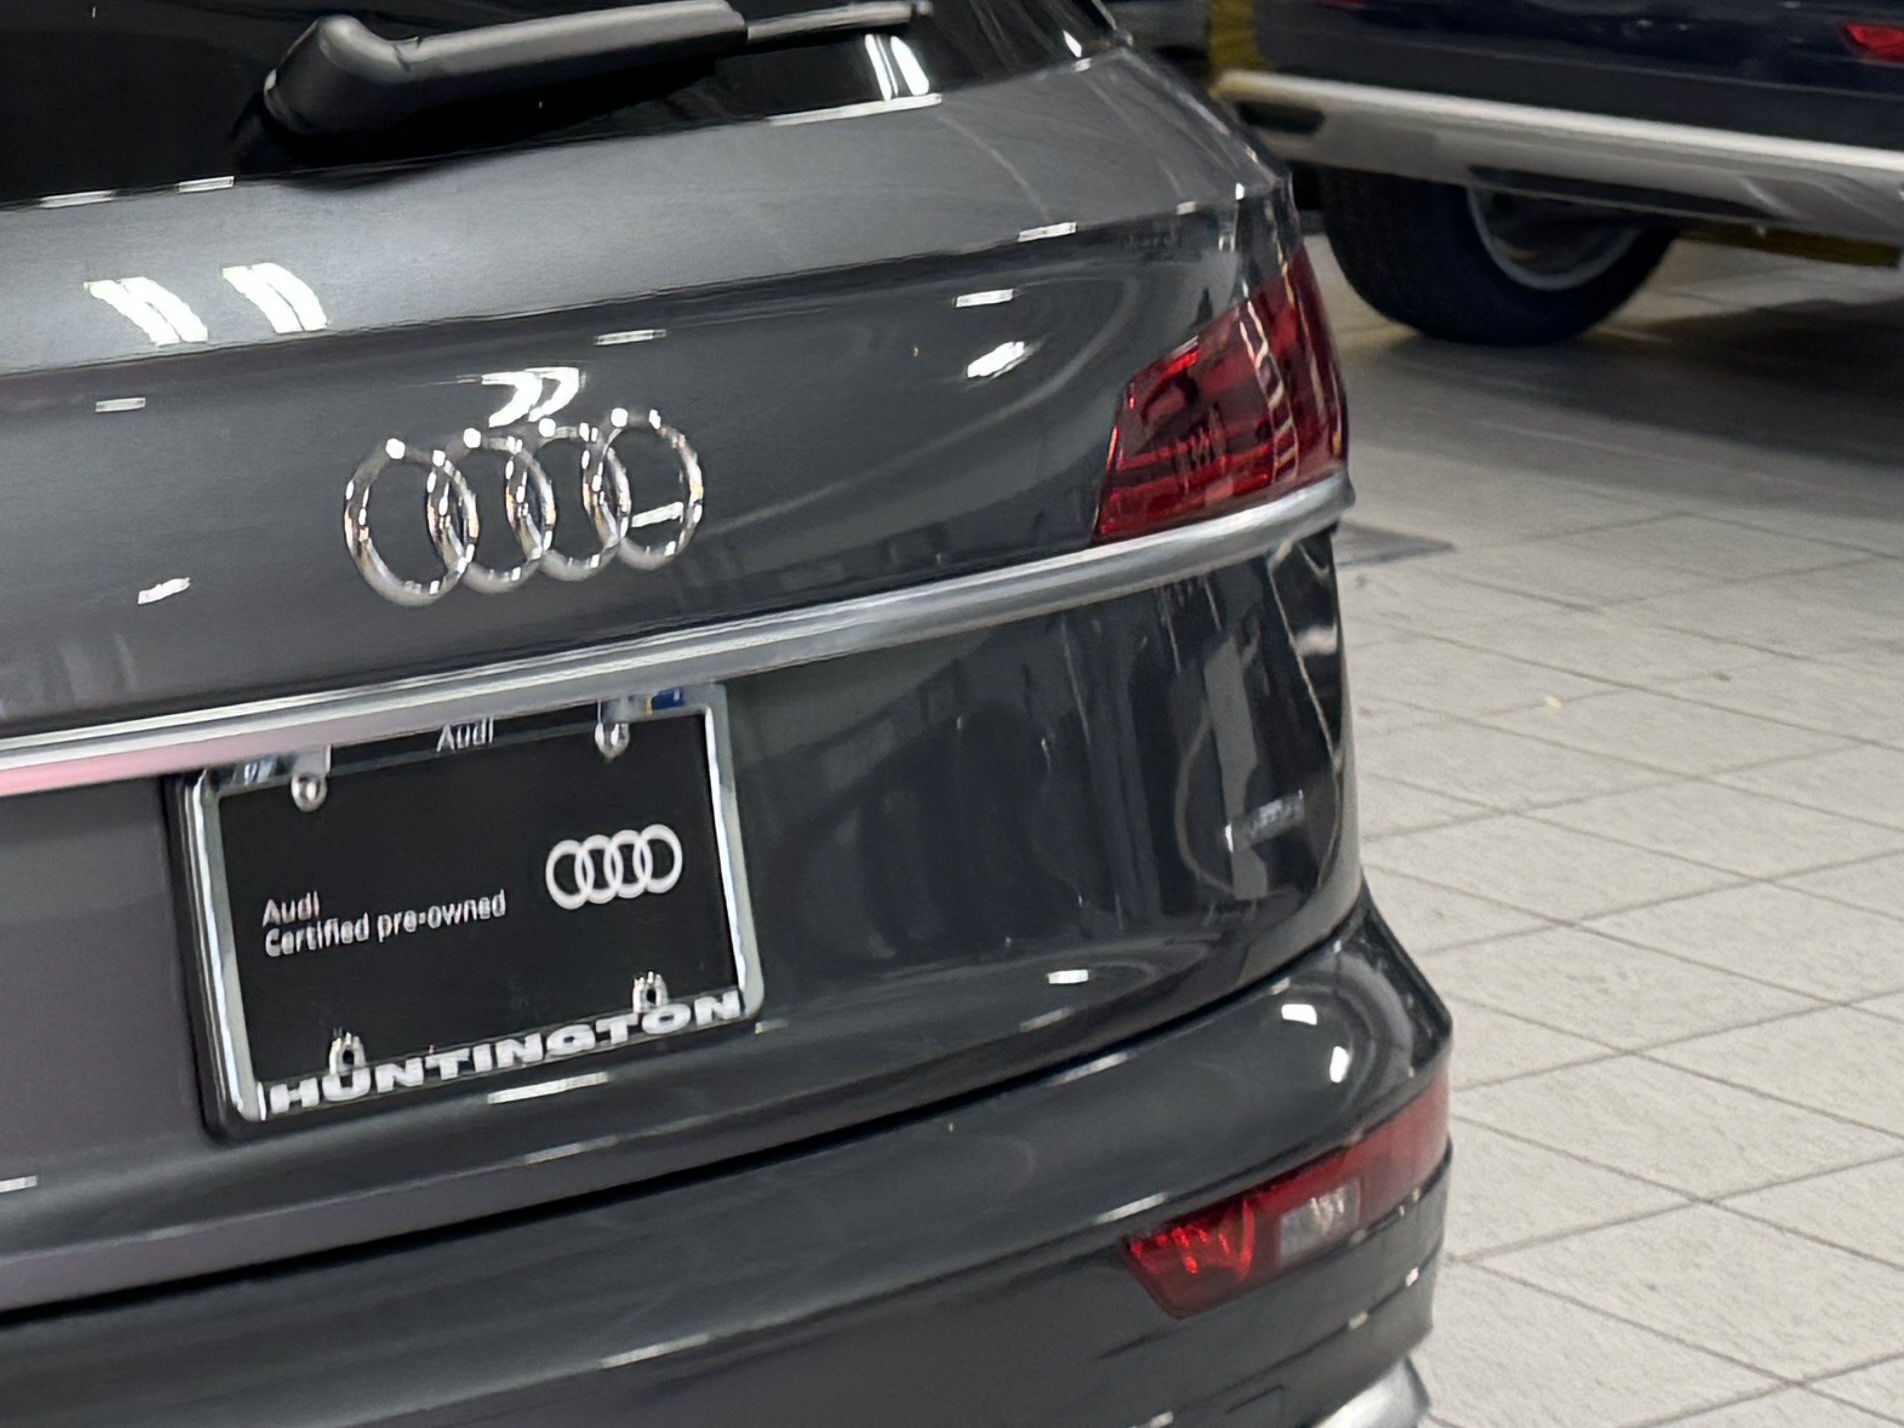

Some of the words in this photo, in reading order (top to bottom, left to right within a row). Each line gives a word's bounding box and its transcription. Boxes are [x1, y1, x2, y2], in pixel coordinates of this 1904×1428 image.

[436, 717, 493, 753] Audi
[262, 890, 321, 928] Audi
[264, 912, 370, 958] Certified
[377, 888, 507, 943] pre-owned
[269, 988, 744, 1115] HUNTINGTON
